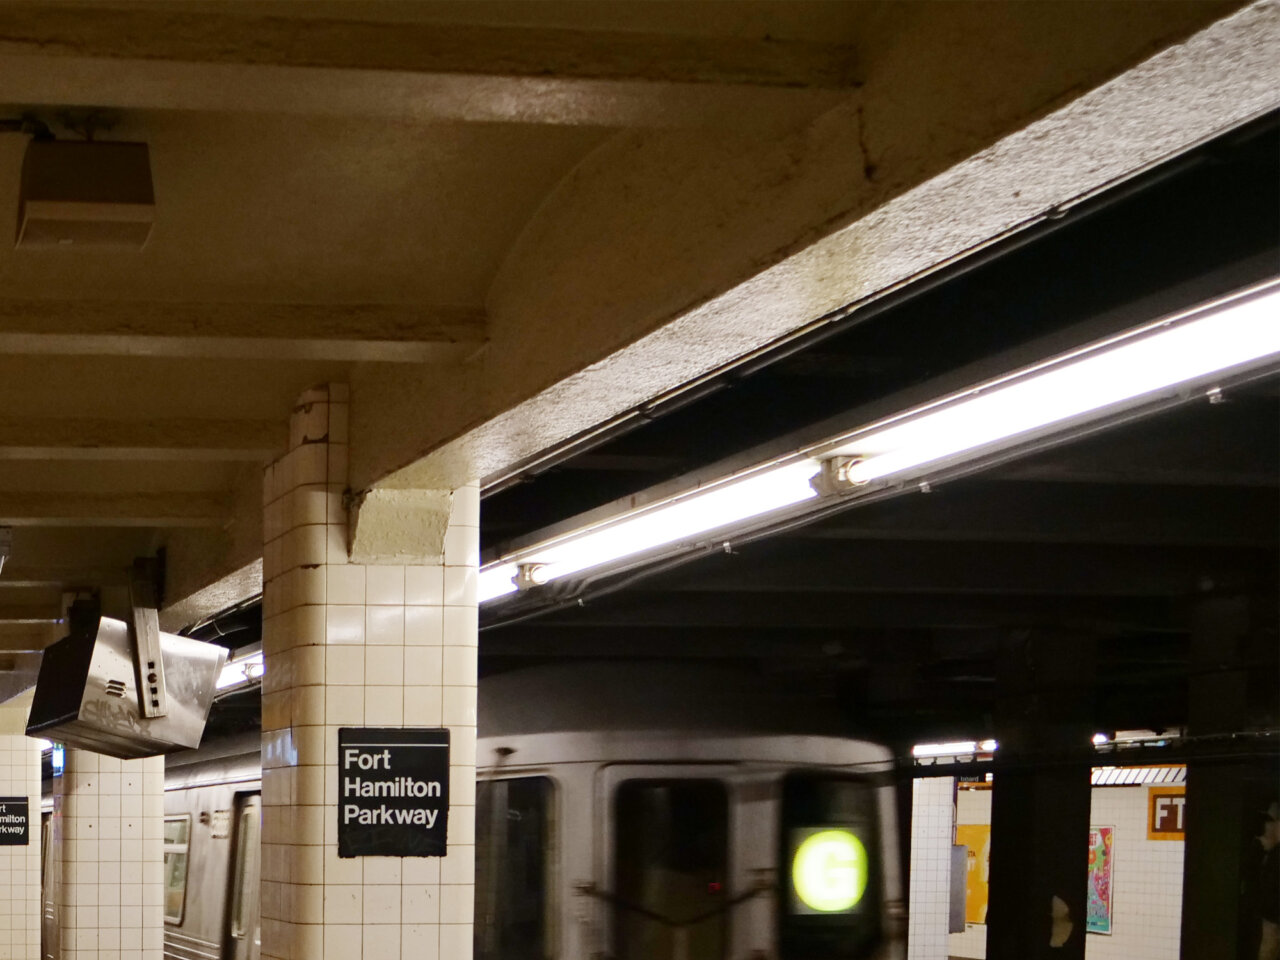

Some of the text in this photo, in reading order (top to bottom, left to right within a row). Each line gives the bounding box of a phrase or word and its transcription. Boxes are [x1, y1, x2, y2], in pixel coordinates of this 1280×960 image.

[344, 749, 392, 770] Fort
[344, 776, 441, 798] Hamilton
[344, 804, 439, 829] Parkway
[803, 840, 859, 900] G
